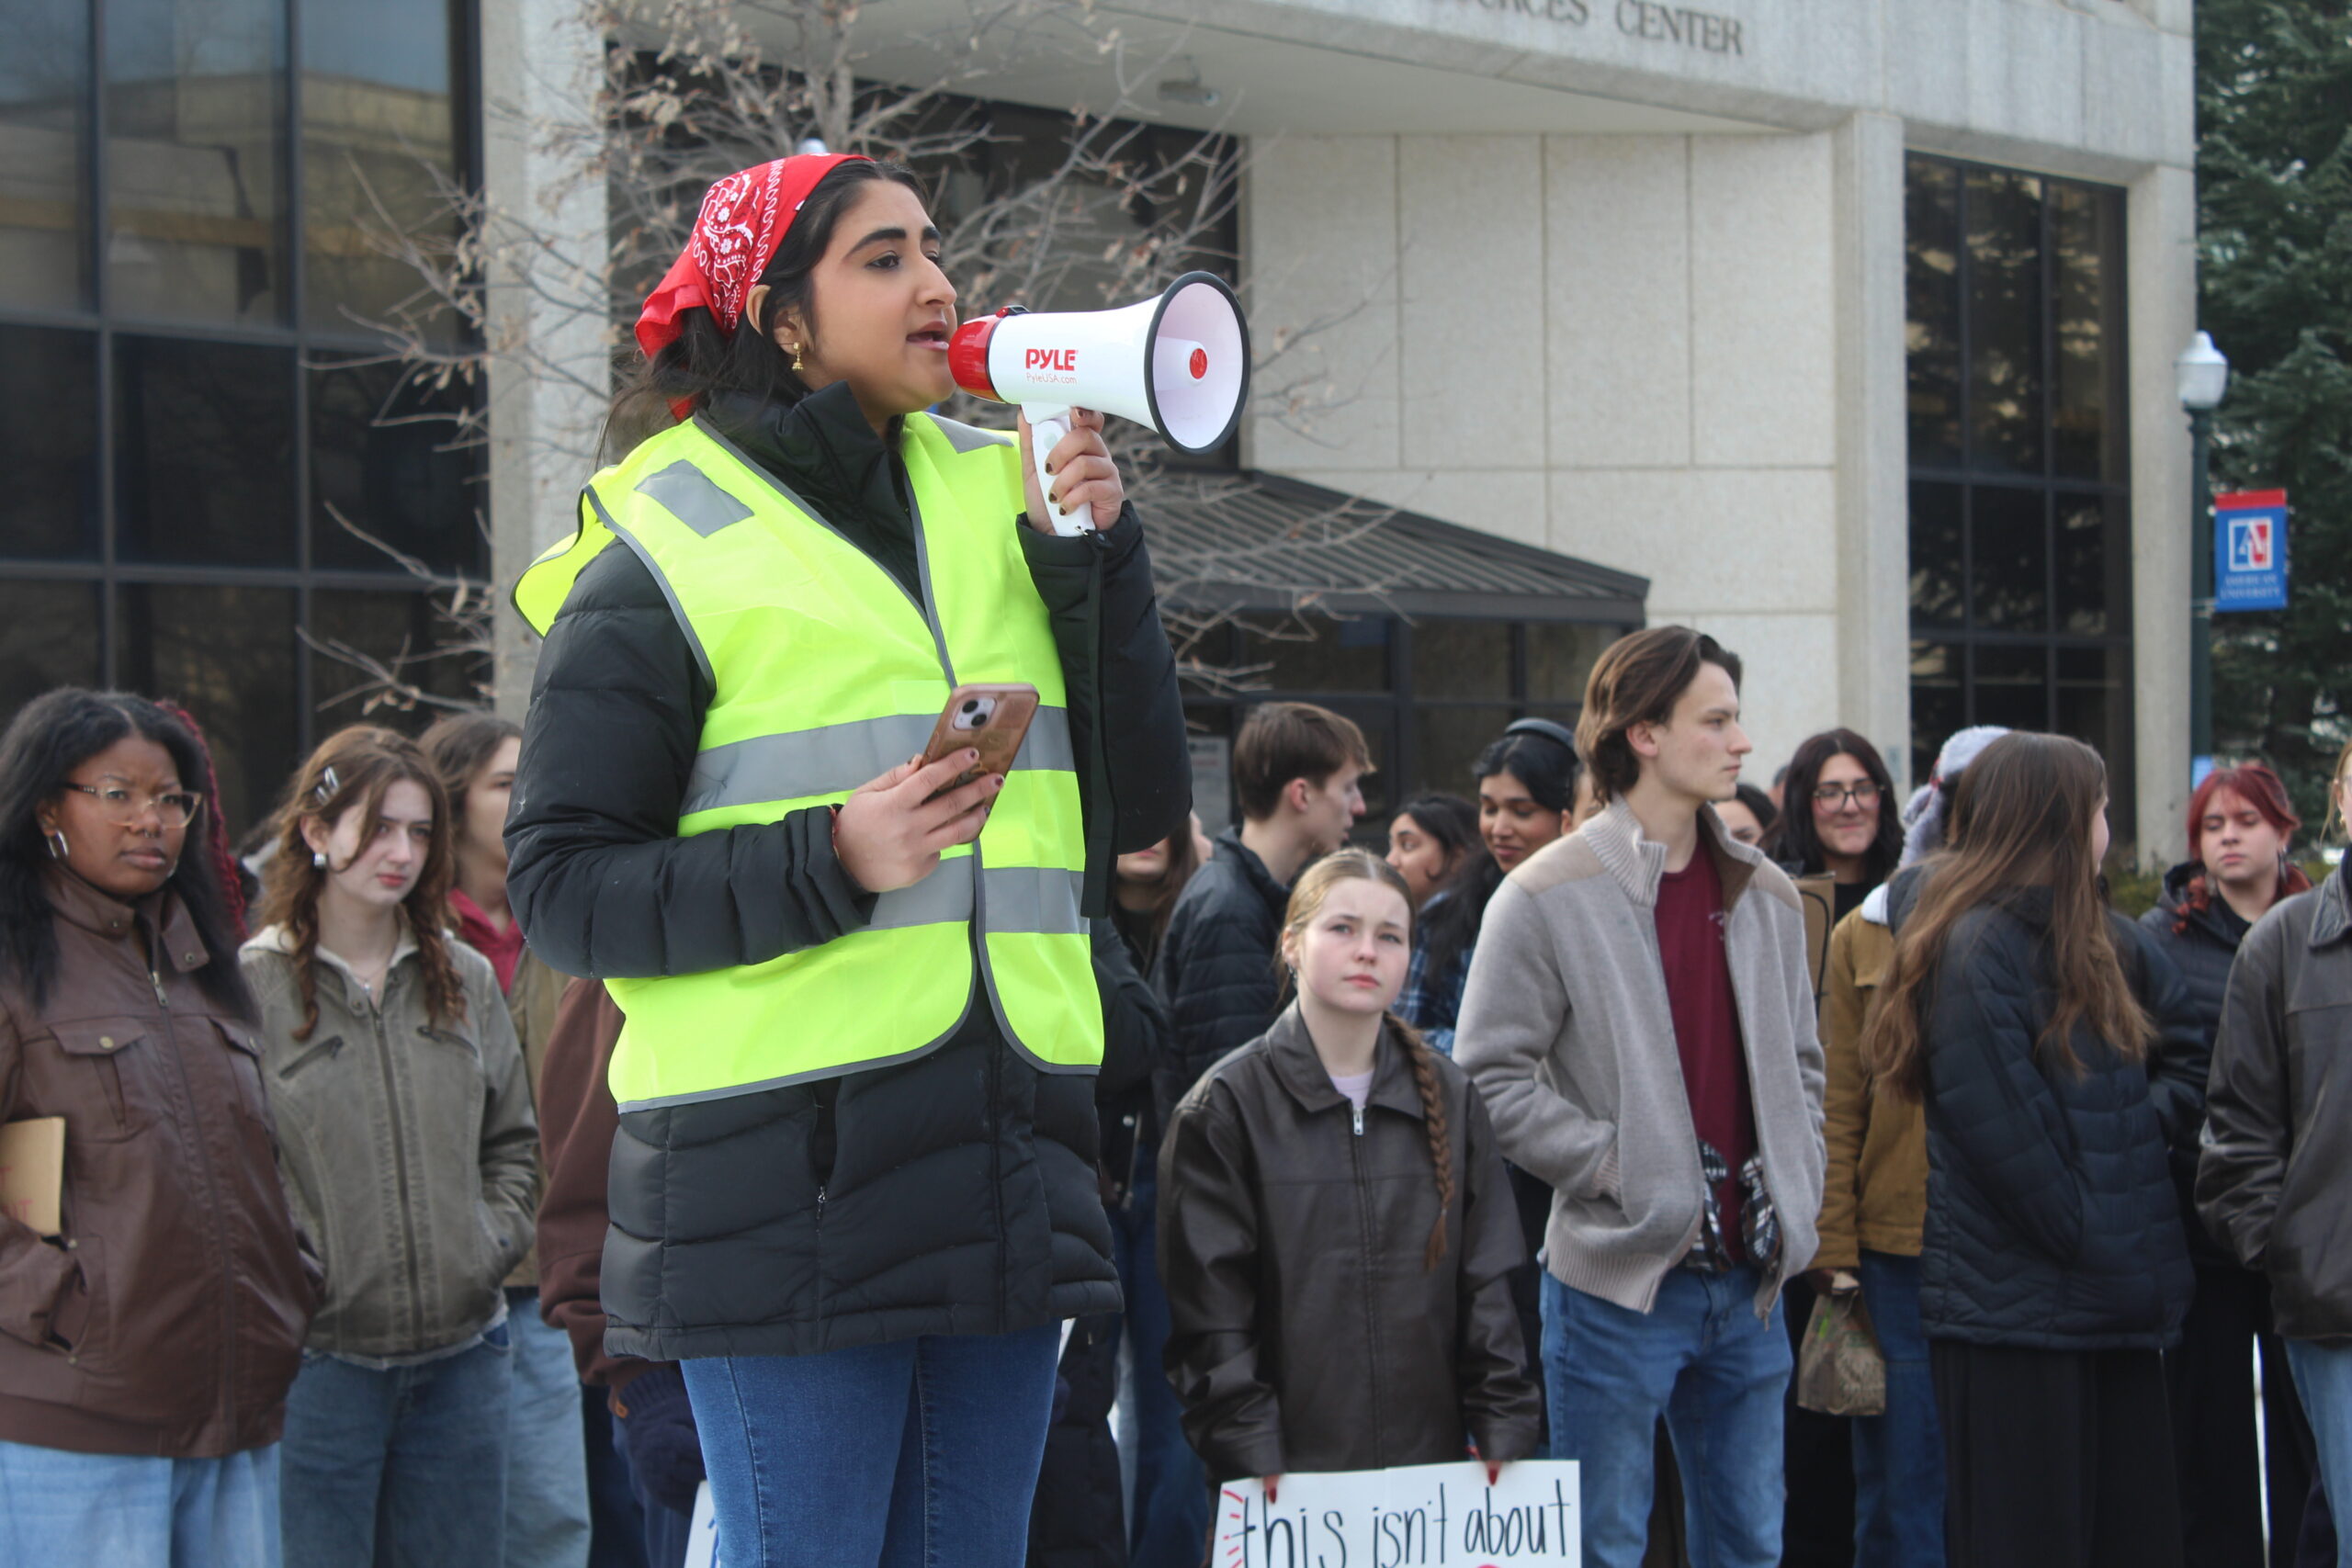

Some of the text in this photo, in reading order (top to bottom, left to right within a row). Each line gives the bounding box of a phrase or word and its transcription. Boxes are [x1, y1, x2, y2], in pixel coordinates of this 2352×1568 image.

[1614, 0, 1743, 55] CENTER
[1025, 348, 1076, 371] PYLE
[1025, 373, 1078, 384] PyleUSA.com
[1231, 1479, 1571, 1568] this isn't about
